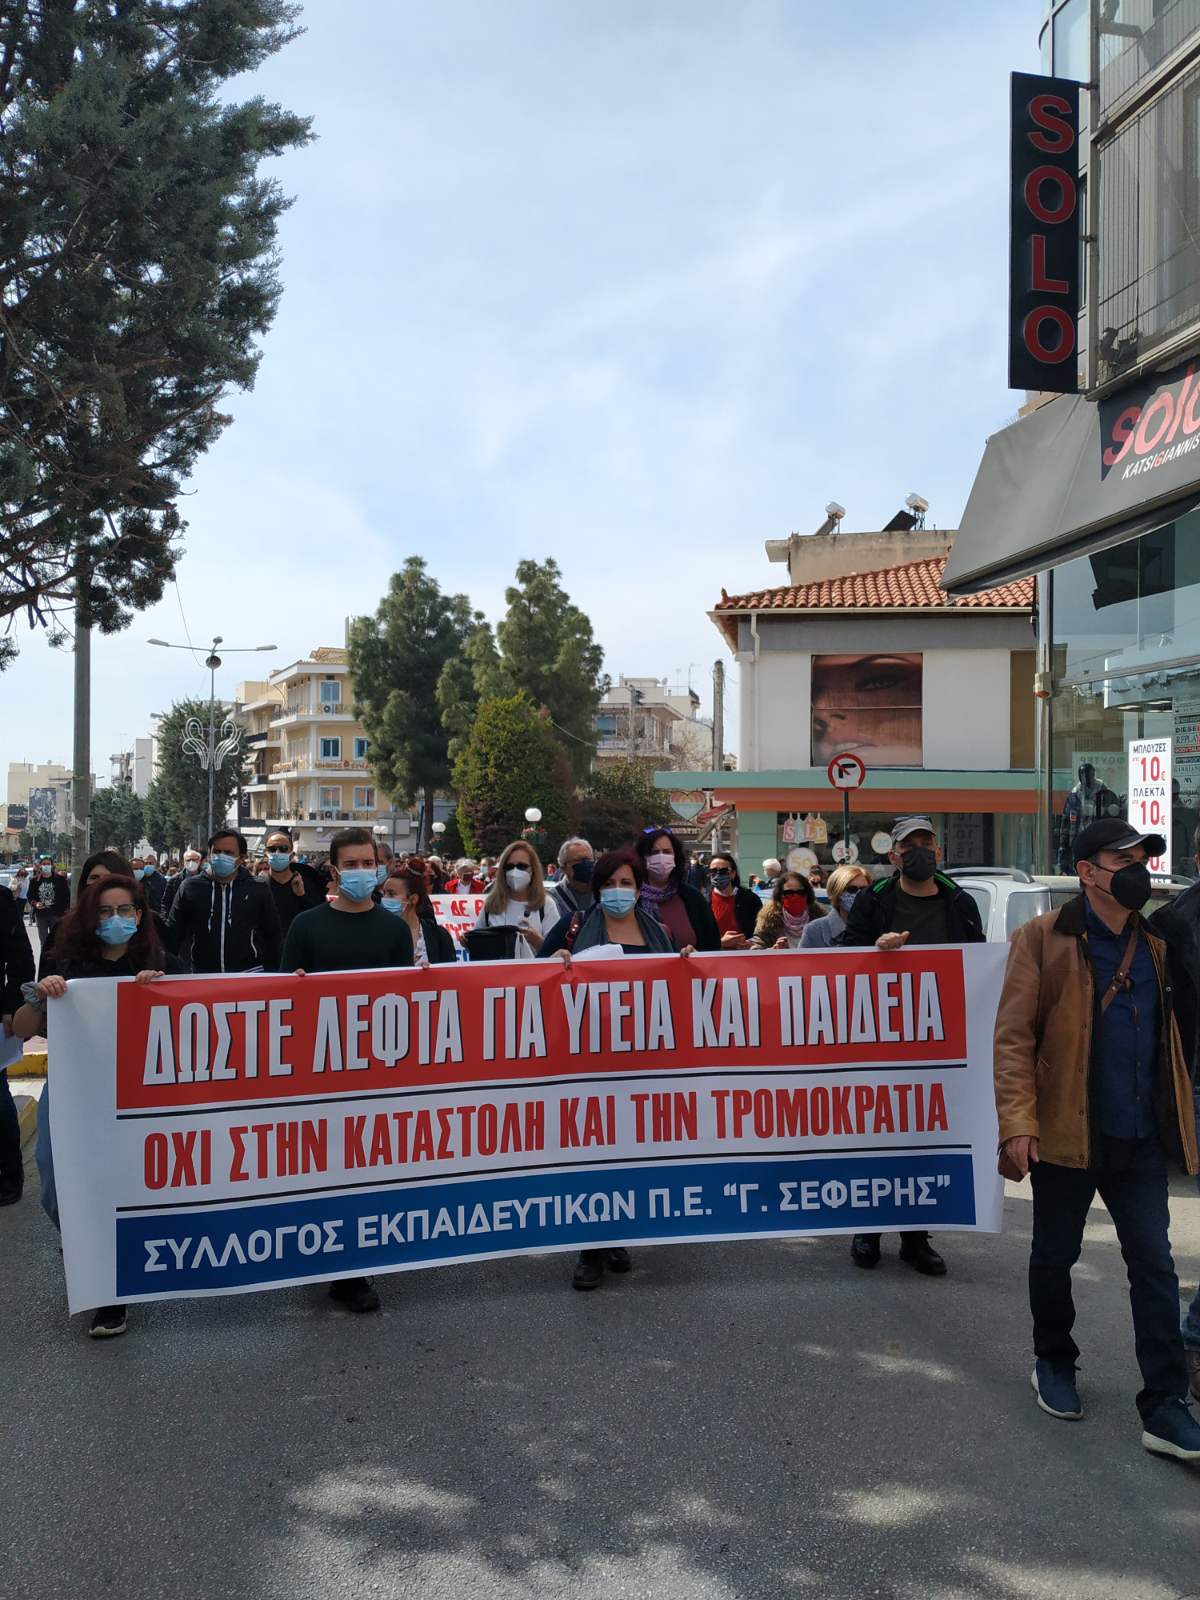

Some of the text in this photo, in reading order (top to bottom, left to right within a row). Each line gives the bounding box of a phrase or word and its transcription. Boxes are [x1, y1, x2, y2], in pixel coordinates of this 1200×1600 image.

[1023, 94, 1077, 365] SOLO
[1122, 432, 1200, 481] KATSIGIANNIS
[1132, 742, 1168, 754] ΜΠΛΟΥΖΕΣ
[1132, 787, 1165, 797] ΠΛΕΚΤΑ
[143, 971, 944, 1086] ΔΩΣΤΕ ΛΕΦΤΑ ΓΙΑ ΥΓΕΙΑ ΚΑΙ ΠΑΙΔΕΙΑ
[144, 1083, 949, 1190] ΟΧΙ ΣΤΗΝ ΚΑΤΑΣΤΟΛΗ ΚΑΙ ΤΗΝ ΤΡΟΜΟΚΡΑΤΙΑ
[144, 1219, 344, 1273] ΣΥΛΛΟΓΟΣ
[358, 1190, 635, 1249] ΕΚΠΑΙΔΕΥΤΙΚΩΝ
[648, 1186, 712, 1219] Π.Ε.
